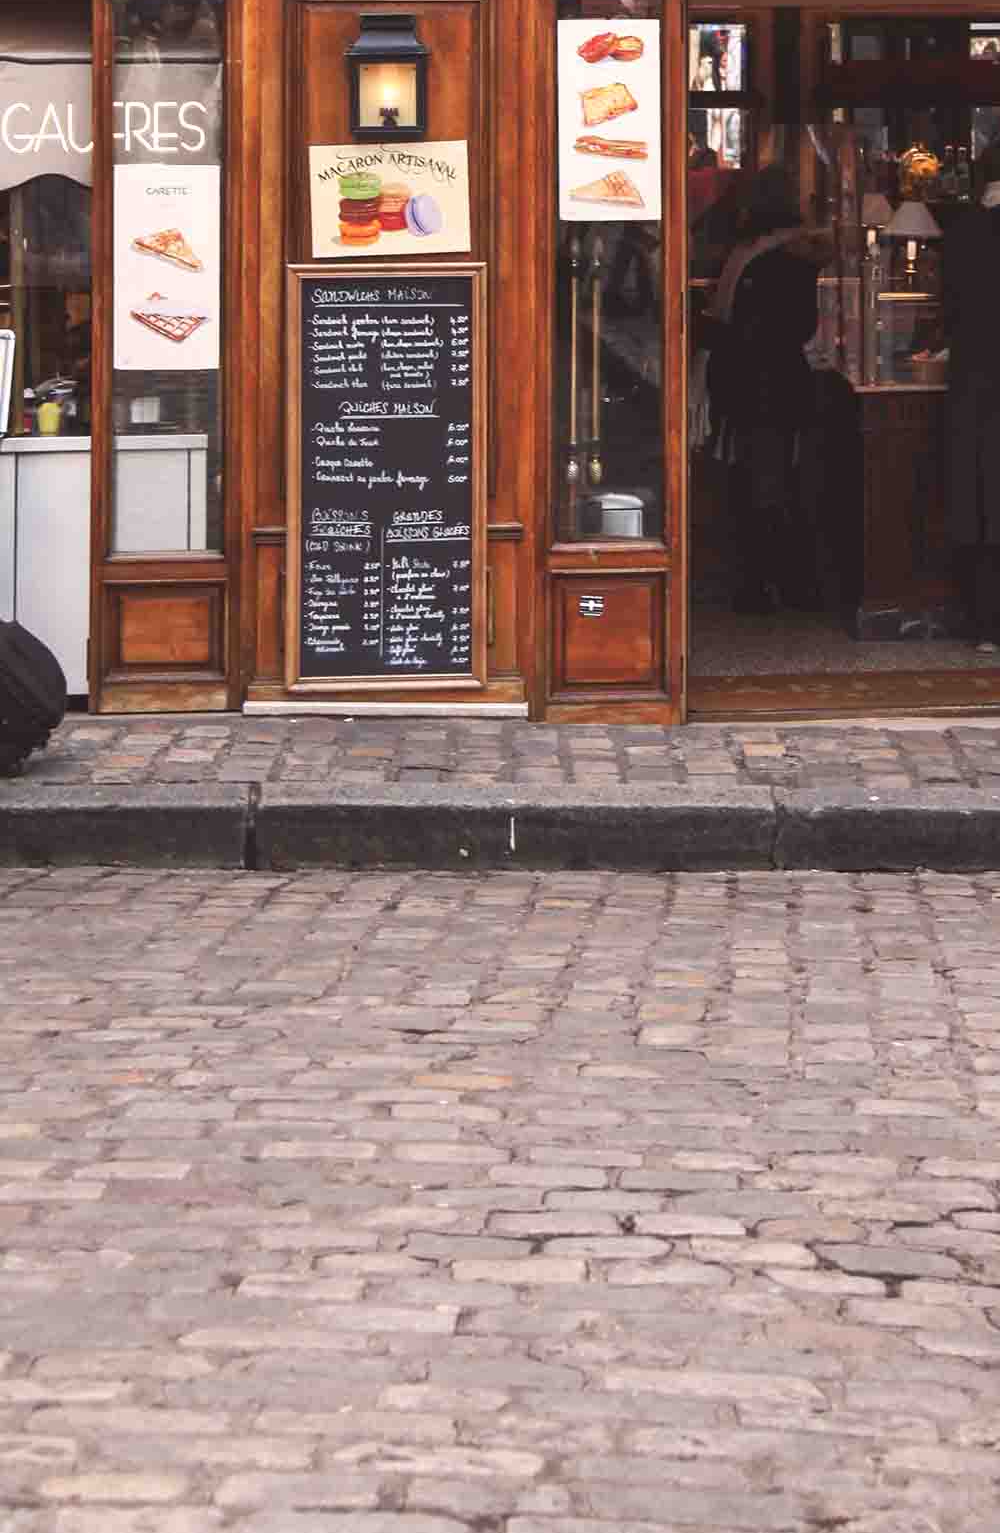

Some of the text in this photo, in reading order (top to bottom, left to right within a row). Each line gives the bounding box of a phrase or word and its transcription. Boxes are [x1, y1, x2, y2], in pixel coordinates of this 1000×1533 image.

[317, 150, 457, 182] MACARON ARTISANAL
[145, 186, 191, 196] CARETTE
